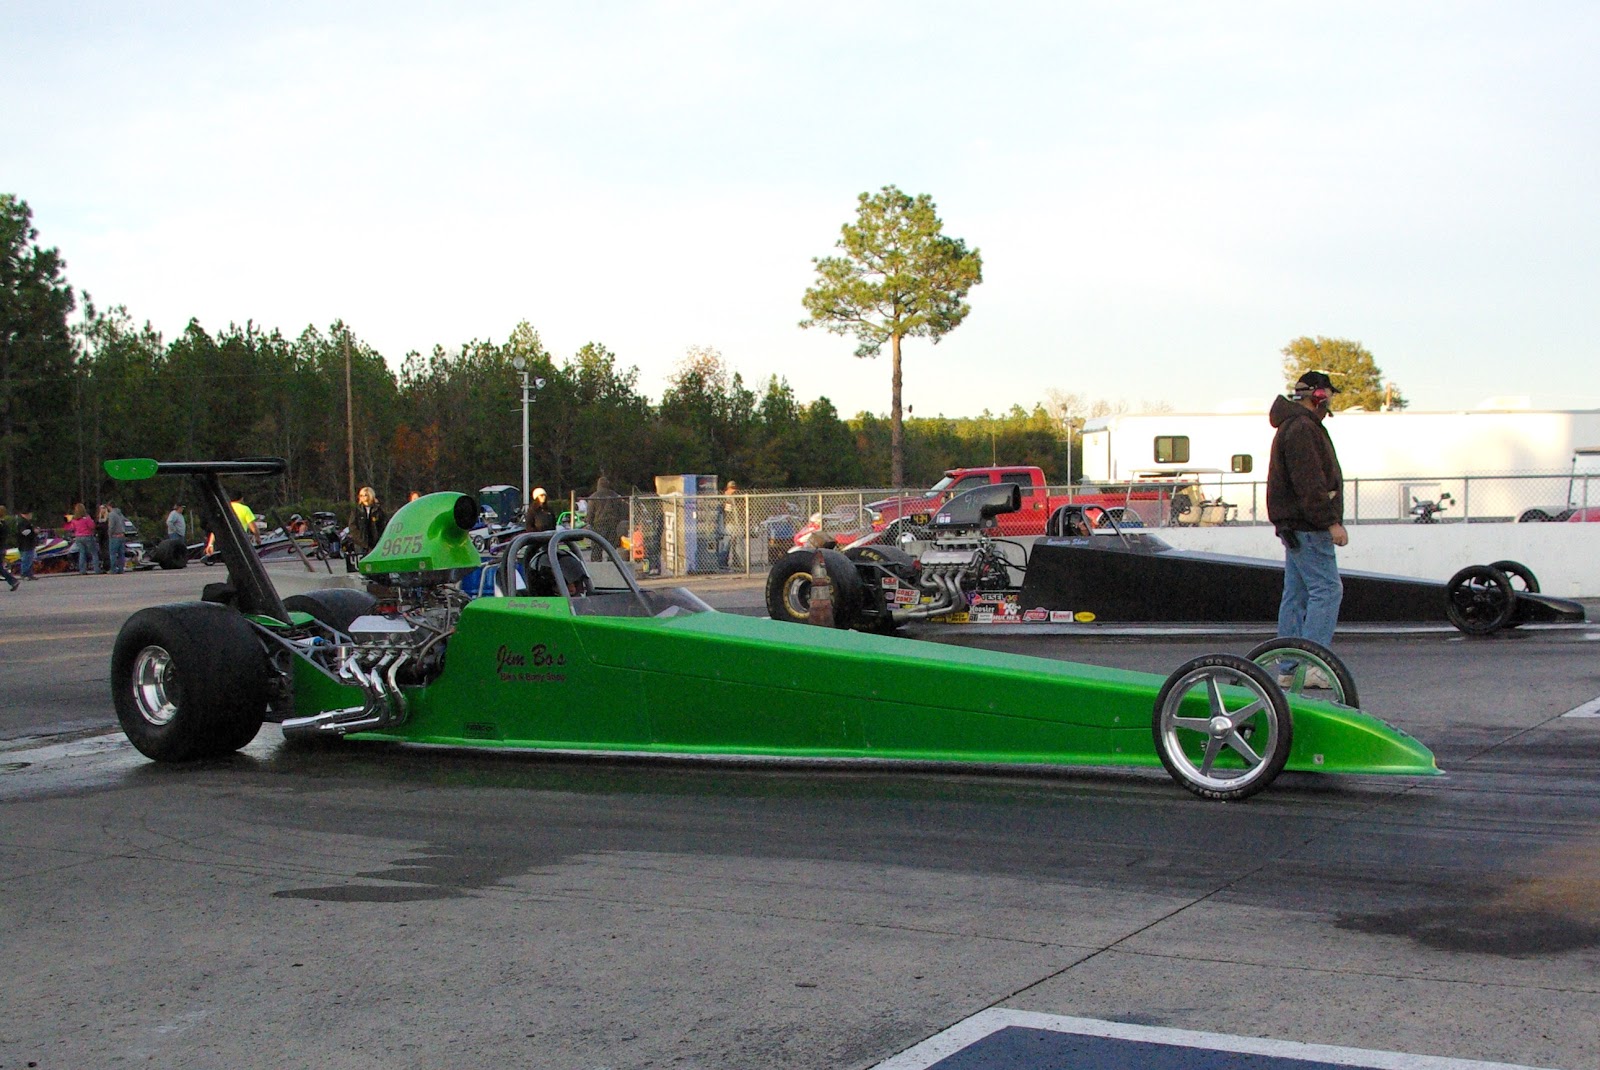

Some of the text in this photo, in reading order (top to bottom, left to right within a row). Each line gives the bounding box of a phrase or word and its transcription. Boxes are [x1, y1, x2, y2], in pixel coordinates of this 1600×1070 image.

[381, 535, 423, 557] 9675
[969, 605, 995, 613] Hoosier
[496, 643, 566, 673] Jim Bo's
